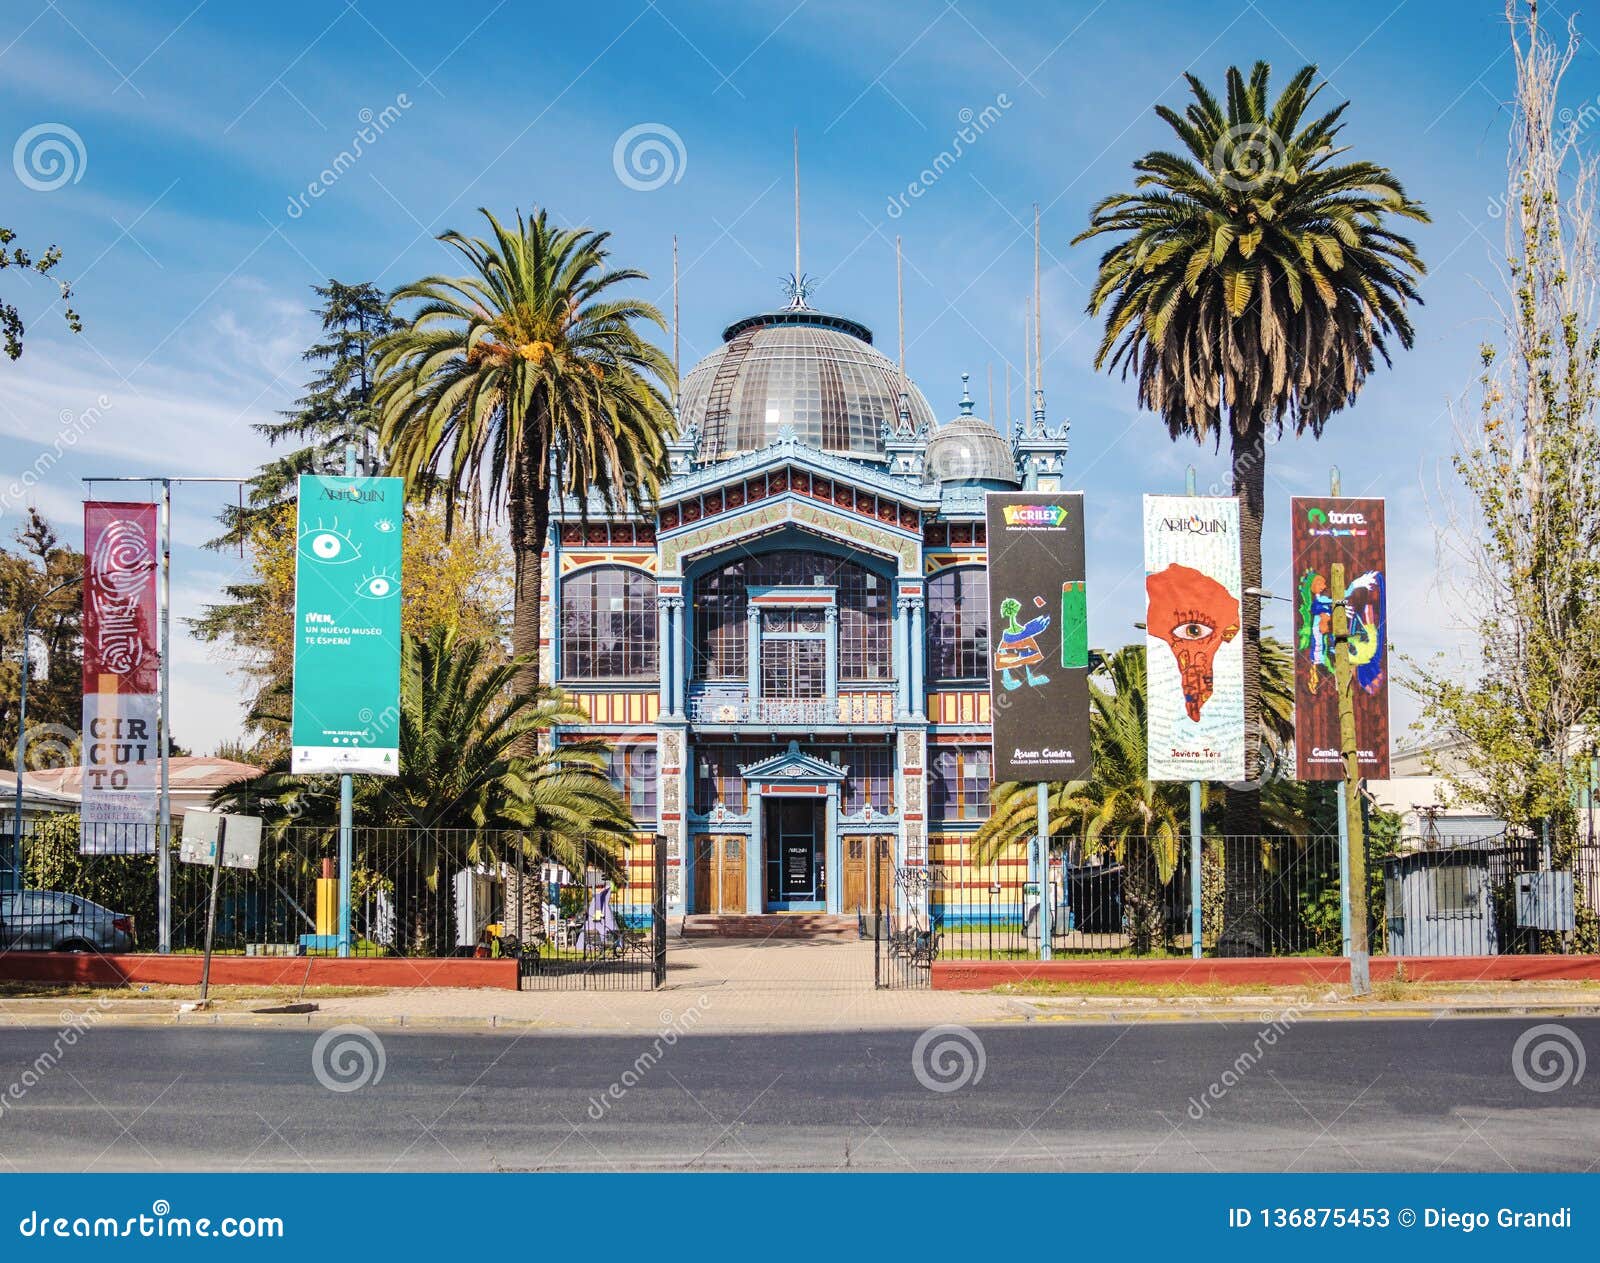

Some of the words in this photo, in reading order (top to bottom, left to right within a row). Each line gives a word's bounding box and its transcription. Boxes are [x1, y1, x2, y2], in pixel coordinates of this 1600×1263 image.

[1012, 510, 1058, 520] ACRILEX
[1328, 510, 1368, 524] torre.
[90, 718, 149, 740] CIR
[90, 743, 147, 765] CUI
[88, 769, 128, 790] TO
